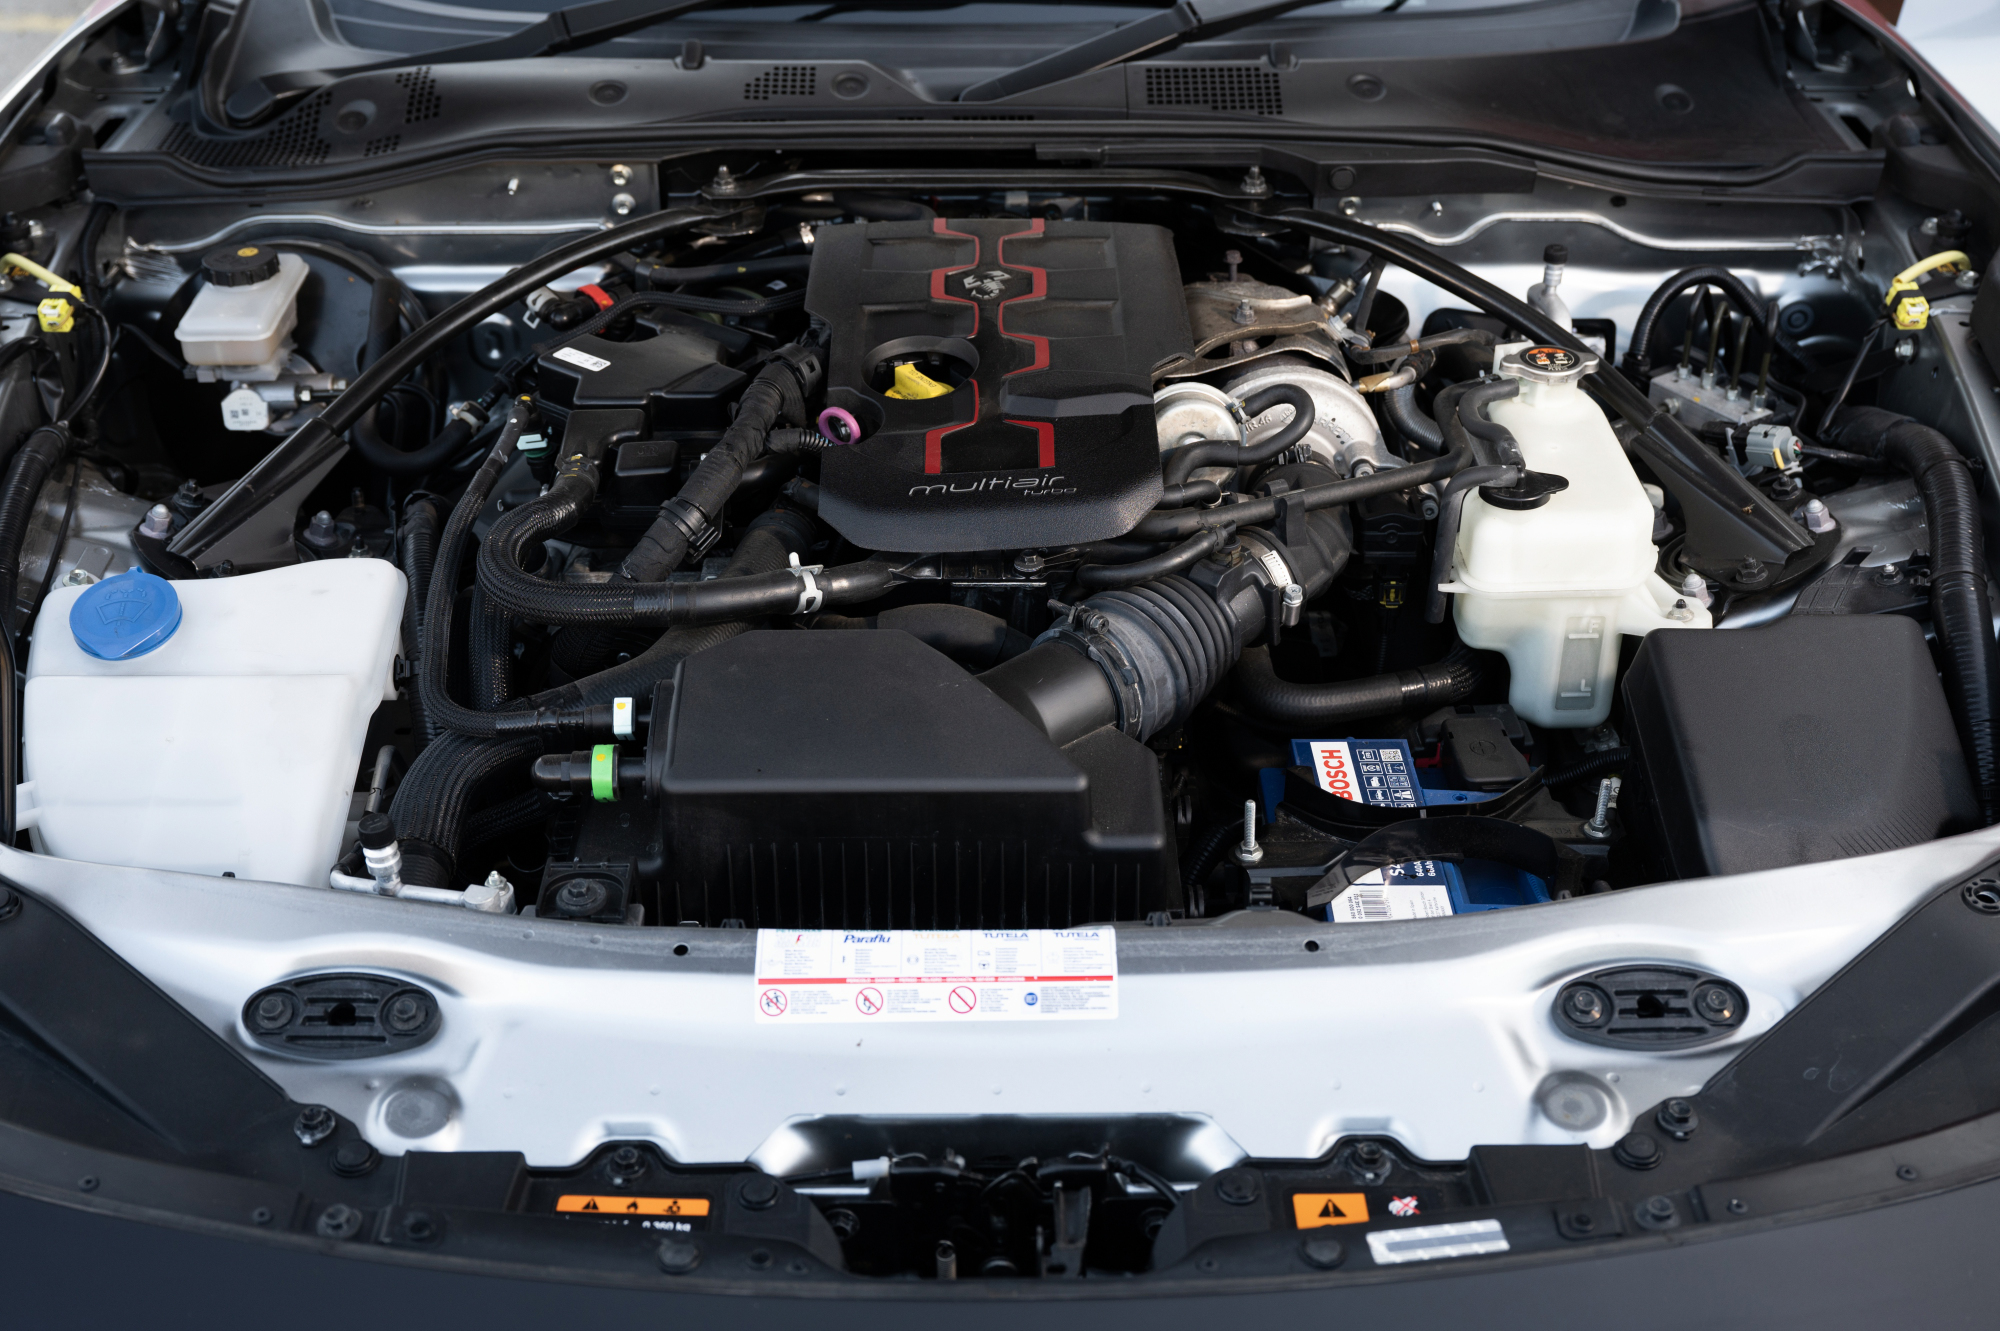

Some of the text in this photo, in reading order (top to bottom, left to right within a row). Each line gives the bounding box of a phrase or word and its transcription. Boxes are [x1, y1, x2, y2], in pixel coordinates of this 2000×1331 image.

[908, 474, 1065, 496] multiair
[1023, 487, 1077, 496] turbo
[1581, 679, 1592, 691] L
[843, 934, 891, 944] Paraflu
